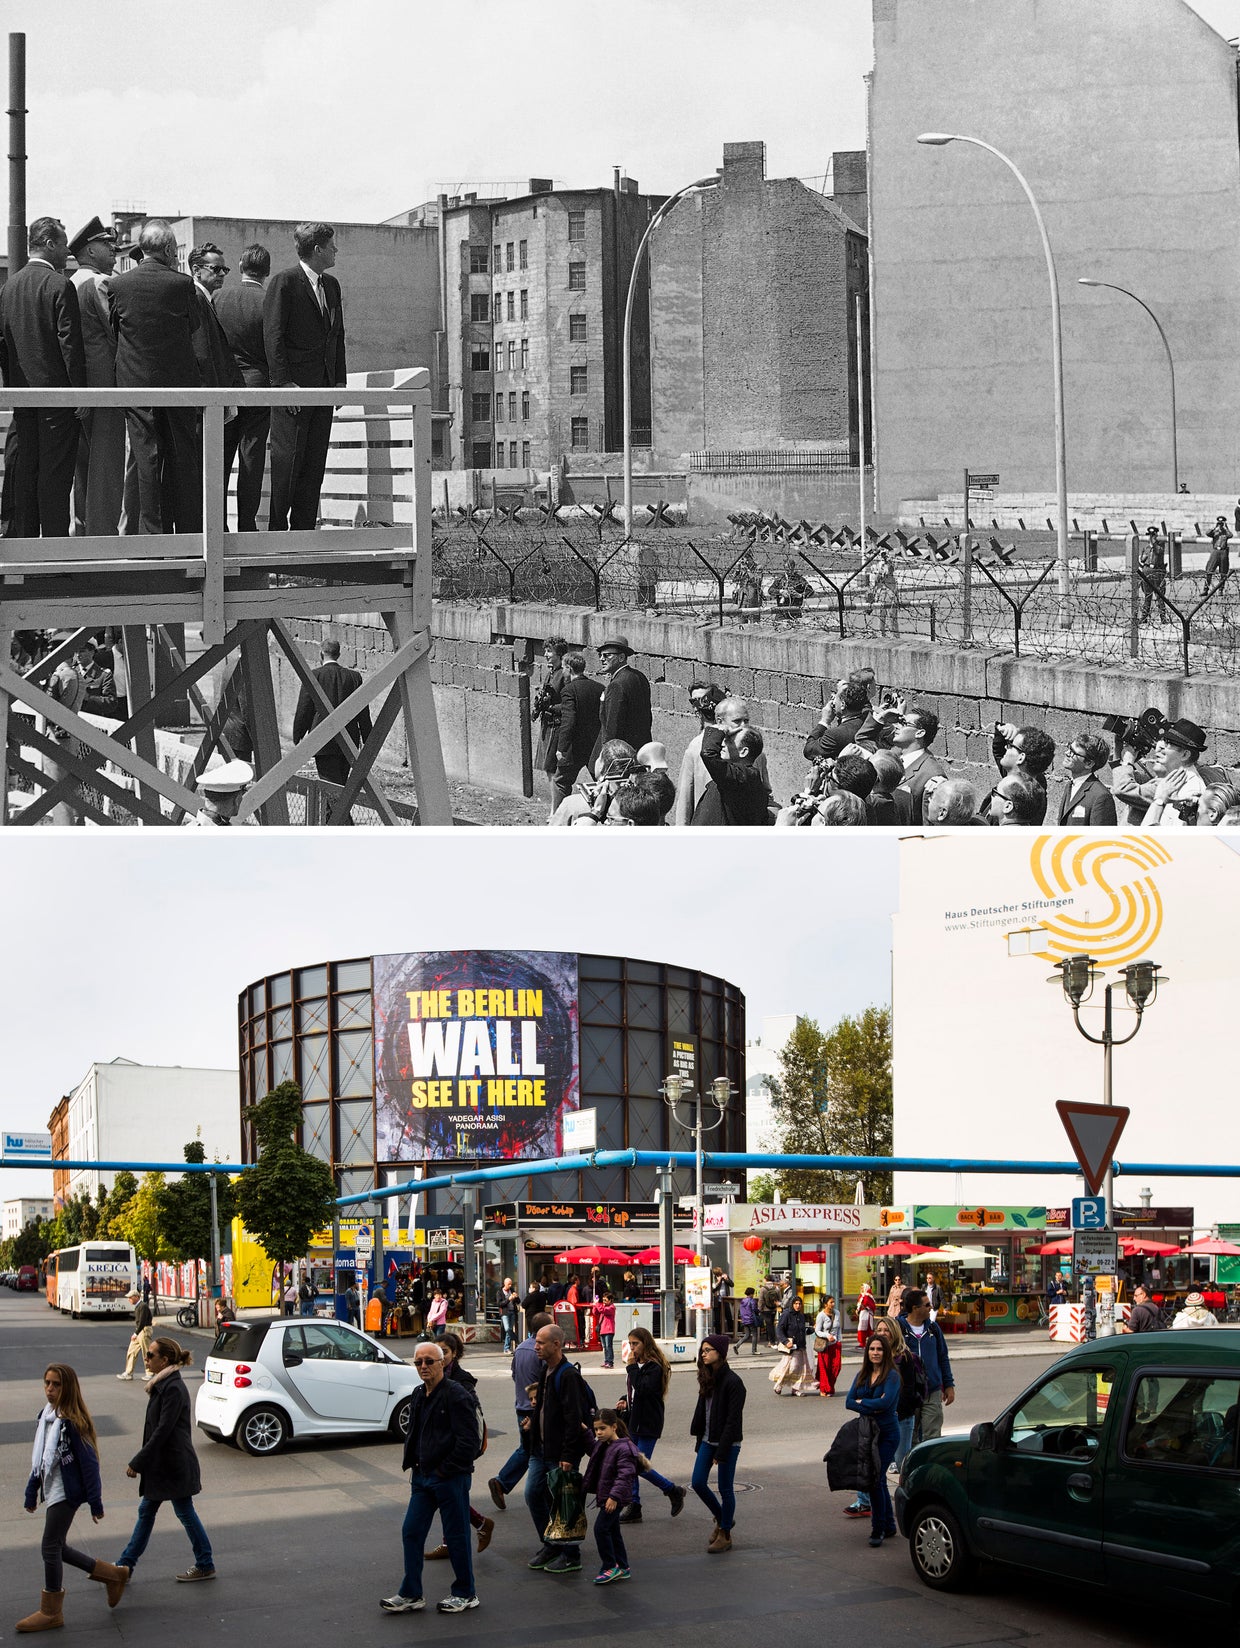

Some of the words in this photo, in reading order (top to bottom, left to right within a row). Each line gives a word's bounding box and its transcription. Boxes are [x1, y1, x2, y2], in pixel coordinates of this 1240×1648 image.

[945, 910, 968, 920] Haus
[971, 905, 1019, 917] Deutscher
[1022, 896, 1074, 911] Stiftungen
[945, 915, 1037, 932] www.Stiftungen.org
[406, 990, 452, 1018] THE
[458, 989, 543, 1017] BERLIN
[407, 1020, 545, 1077] WALL
[411, 1080, 453, 1108] SEE
[459, 1080, 481, 1107] IT
[488, 1080, 546, 1107] HERE
[6, 1135, 24, 1148] hw
[525, 1204, 550, 1215] Döner
[551, 1205, 575, 1218] Kebap
[750, 1207, 787, 1227] ASIA
[791, 1208, 861, 1227] EXPRESS
[1080, 1201, 1098, 1225] P
[88, 1263, 129, 1273] KREJČA
[990, 1305, 1004, 1313] BÄR
[673, 1343, 686, 1354] hw
